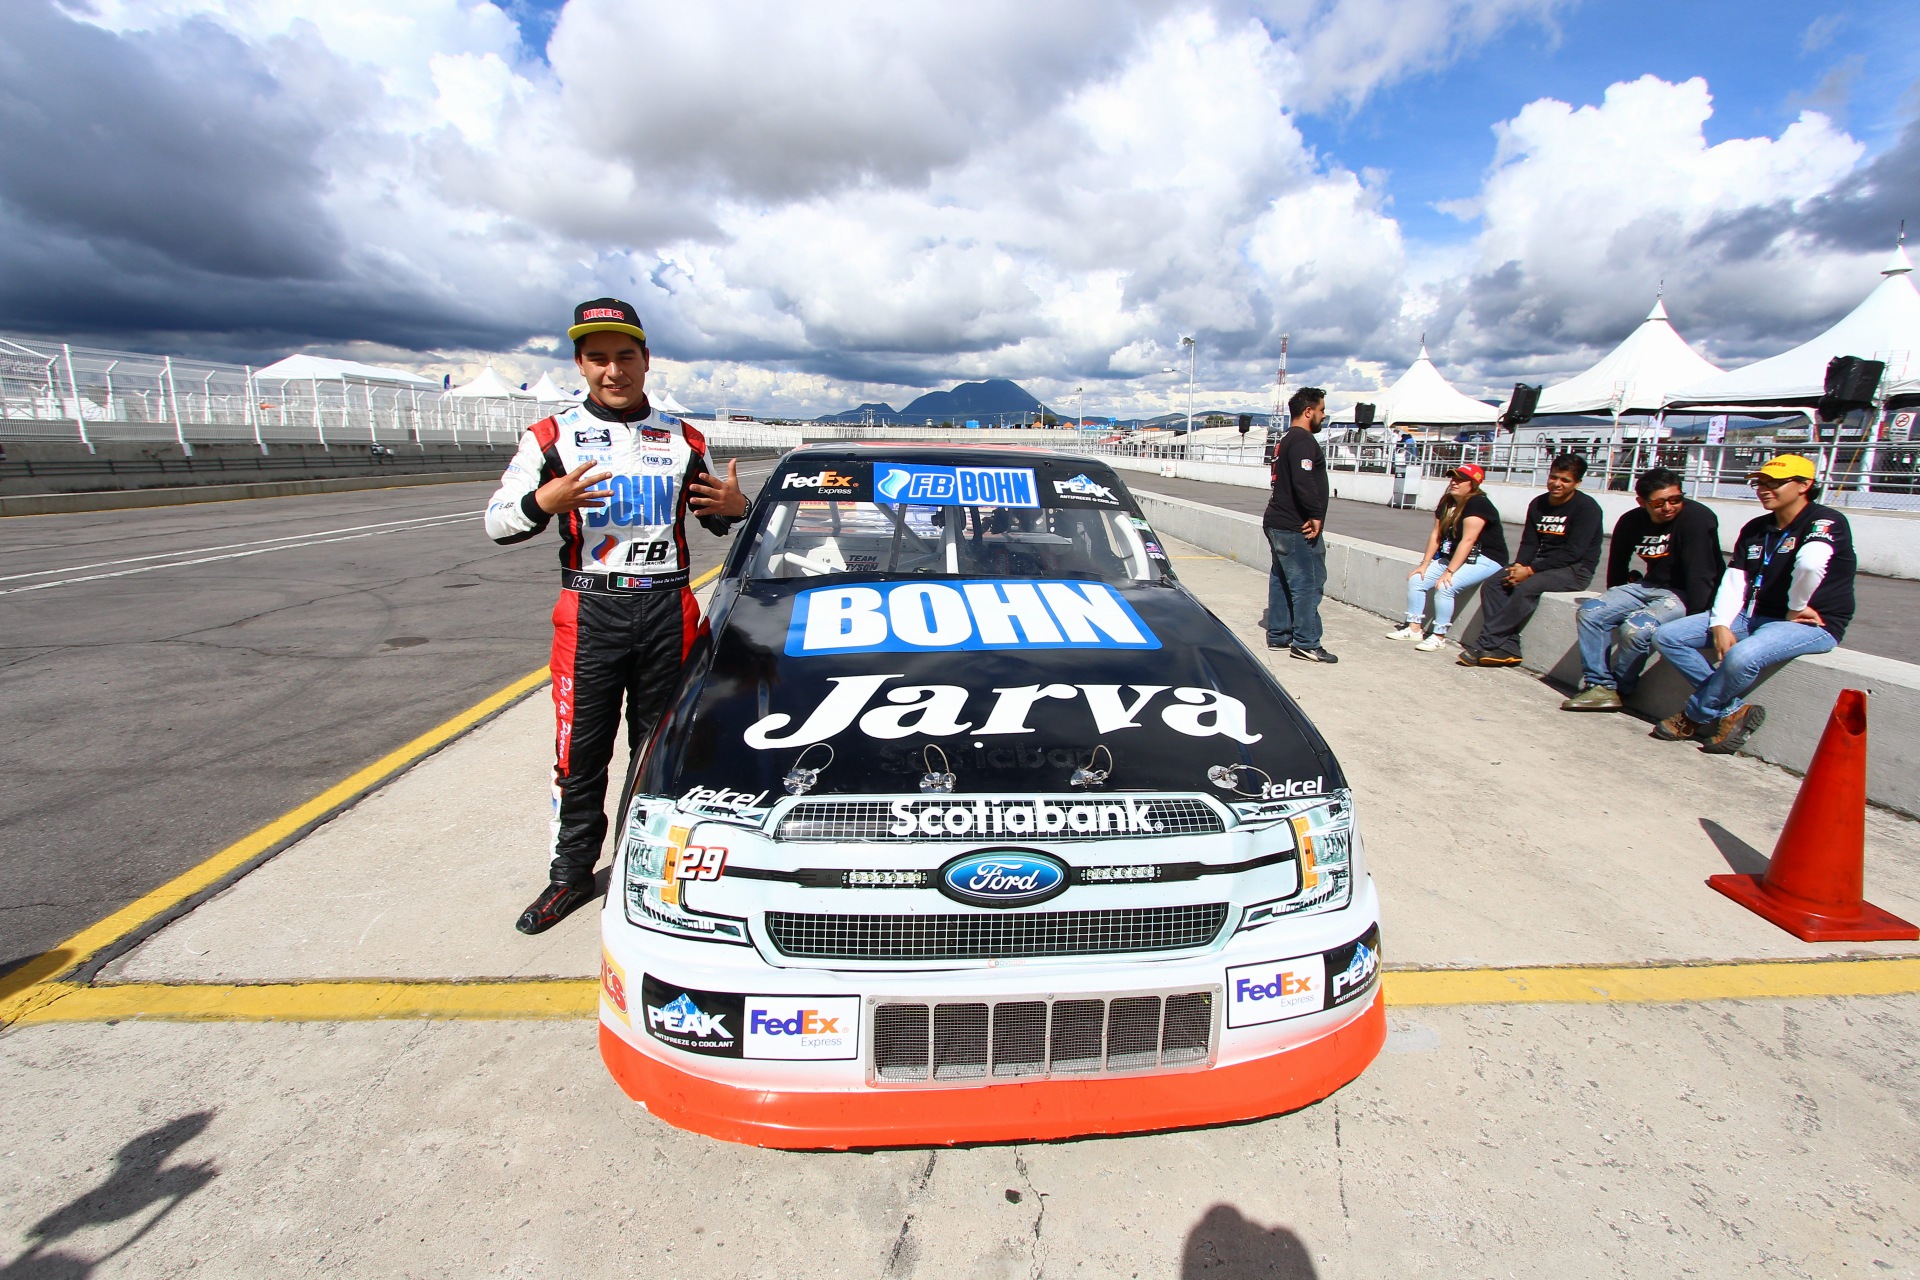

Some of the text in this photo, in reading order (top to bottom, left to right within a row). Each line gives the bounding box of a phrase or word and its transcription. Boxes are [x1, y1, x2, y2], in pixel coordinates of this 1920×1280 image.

[781, 471, 853, 489] FedEx
[909, 472, 1034, 504] FB BOHN
[1053, 480, 1119, 501] PEAK
[818, 487, 852, 496] Express
[1536, 523, 1565, 532] TYSN
[1642, 533, 1670, 544] TEM
[626, 541, 669, 562] FB
[848, 554, 876, 562] TEAM
[846, 563, 879, 572] TYSON
[572, 576, 594, 588] K1
[803, 583, 1148, 650] BOHN
[743, 674, 1263, 750] Jarva
[678, 785, 770, 810] telcel
[1261, 776, 1323, 800] telcel
[890, 797, 1154, 836] Scotiabank
[676, 846, 727, 882] 29
[969, 862, 1040, 890] Ford
[1332, 943, 1380, 998] PEAK
[1236, 971, 1312, 1003] FedEx
[1280, 995, 1316, 1008] Express
[647, 1004, 735, 1039] PEAK
[750, 1009, 839, 1036] FedEx
[654, 1031, 690, 1046] ANTIFREEZE
[698, 1040, 735, 1048] COOLANT
[800, 1037, 843, 1048] Express
